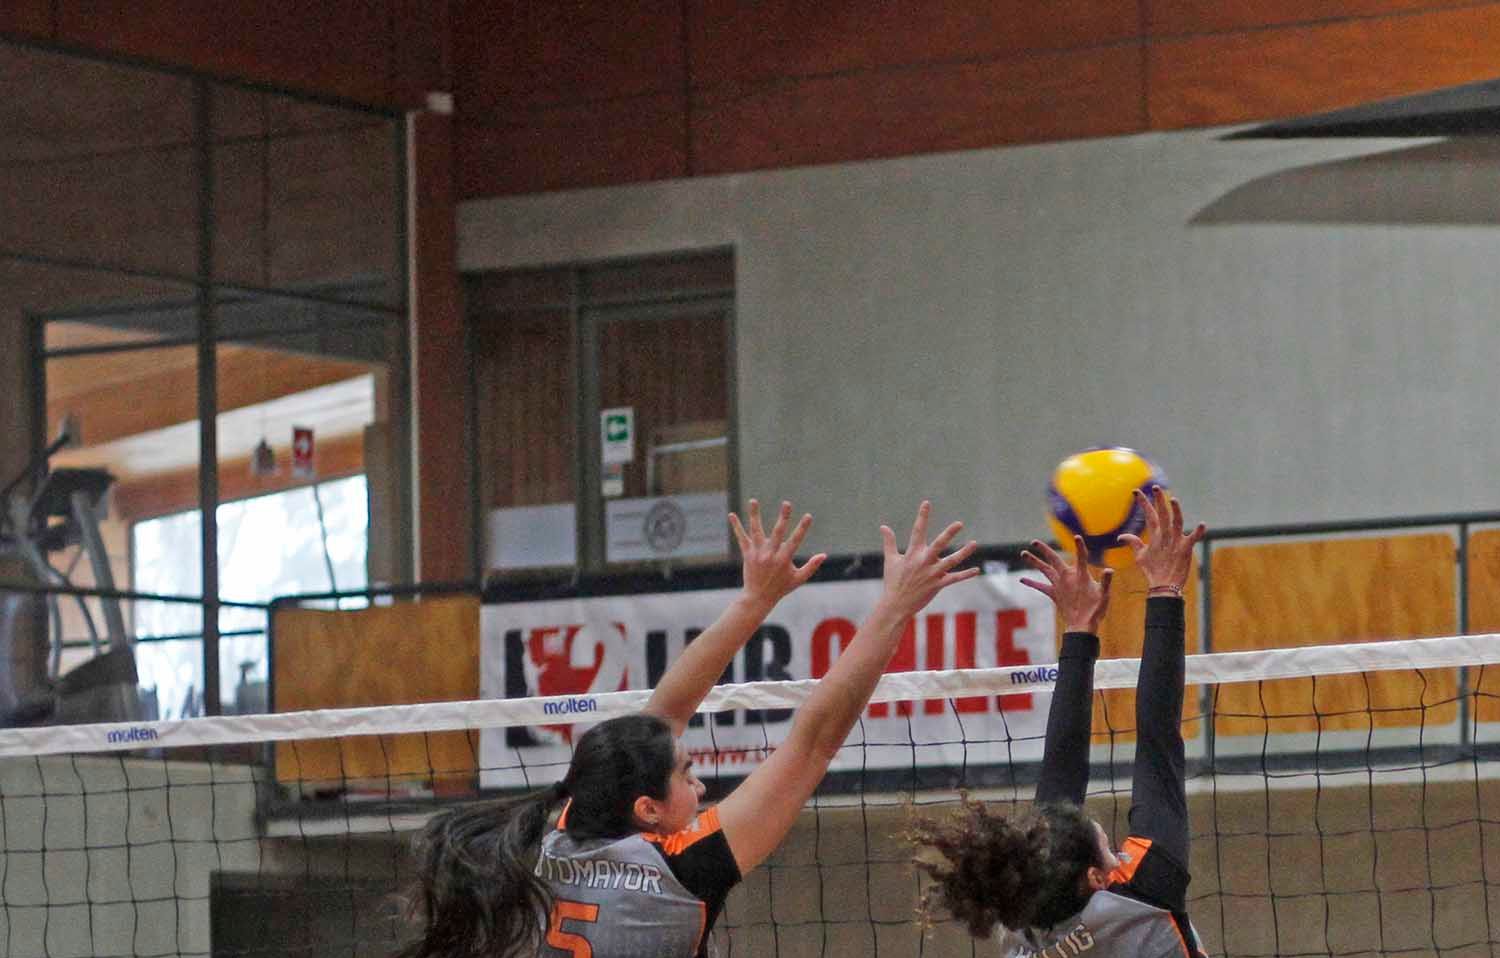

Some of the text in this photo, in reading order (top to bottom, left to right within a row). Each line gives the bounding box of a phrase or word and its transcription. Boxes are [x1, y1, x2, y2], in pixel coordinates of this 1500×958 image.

[1011, 667, 1058, 685] molte
[543, 698, 597, 714] molten
[107, 727, 158, 742] molten
